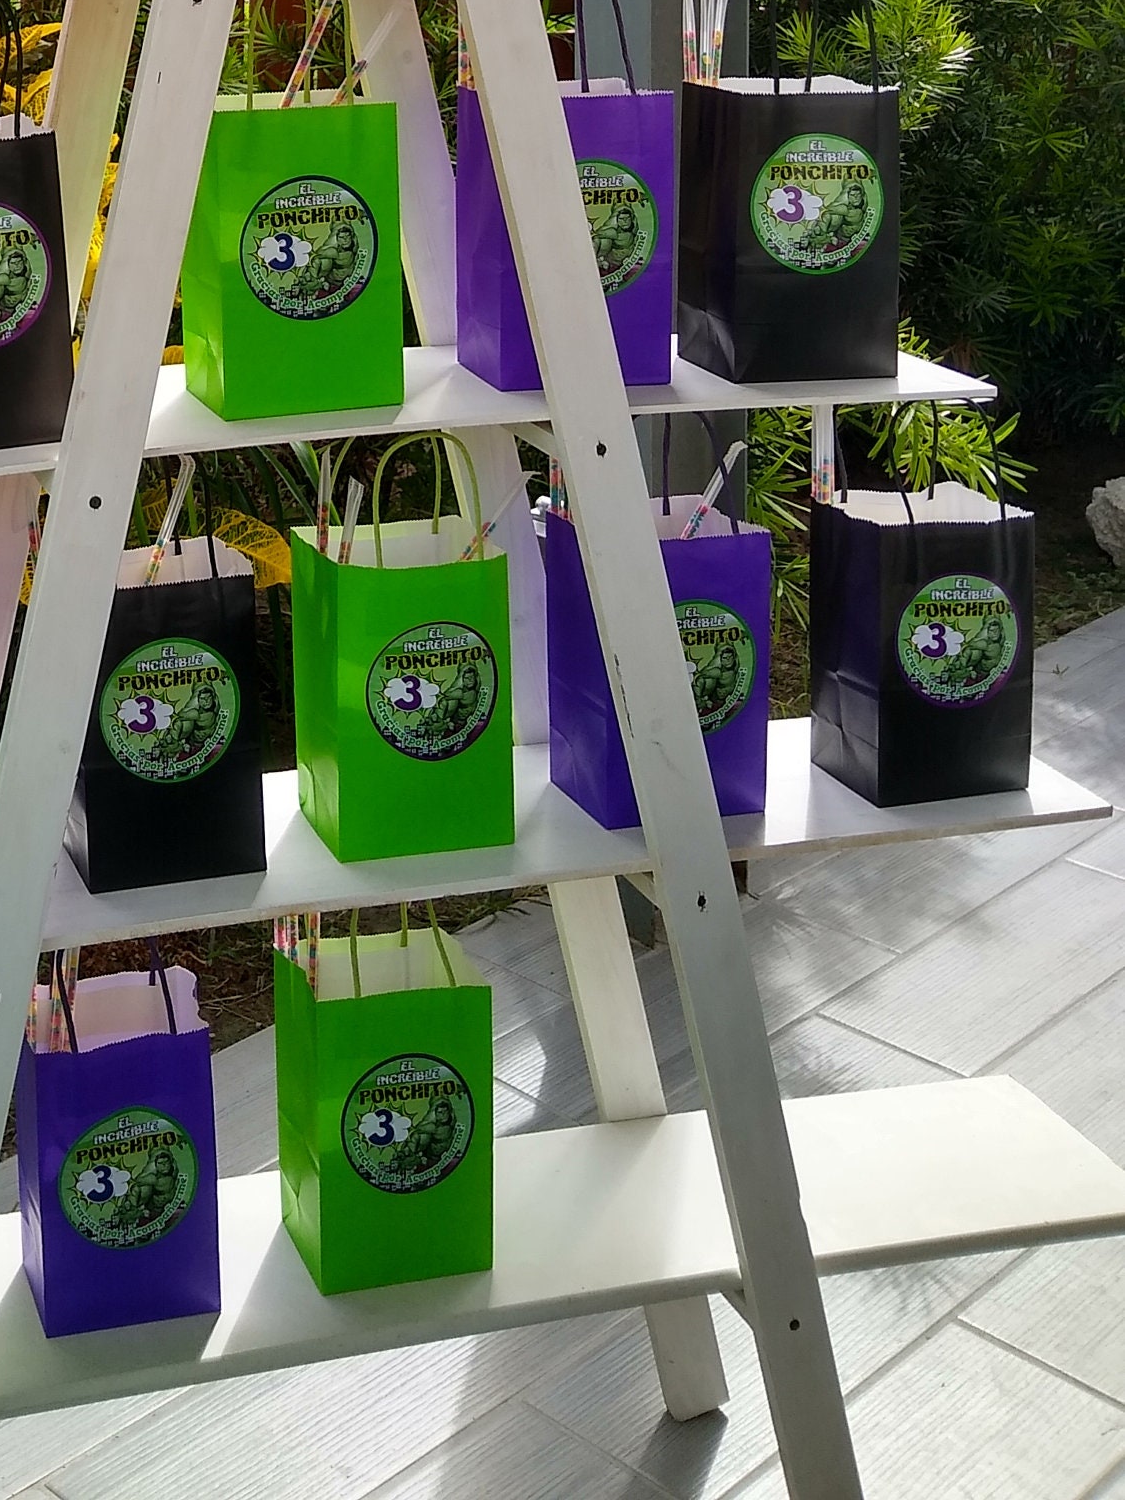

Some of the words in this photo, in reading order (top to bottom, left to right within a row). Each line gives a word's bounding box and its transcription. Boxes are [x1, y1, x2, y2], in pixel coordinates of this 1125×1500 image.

[809, 140, 826, 150] EL
[785, 152, 852, 162] INCREIBLE
[579, 176, 623, 188] REIBLE
[582, 167, 598, 177] EL
[770, 165, 869, 180] PONCHITO
[299, 184, 315, 194] EL
[581, 188, 638, 206] CHITO
[275, 192, 340, 209] INCREIBLE
[777, 186, 804, 222] 3
[258, 204, 357, 229] PONCHITO
[759, 212, 788, 252] Gracias
[790, 251, 811, 260] por
[817, 209, 875, 261] Acompañarme!
[268, 233, 295, 270] 3
[600, 231, 647, 286] ompañarme!
[251, 262, 280, 302] Gracias
[282, 300, 303, 308] por
[308, 249, 366, 308] Acompañarme!
[956, 579, 971, 588] EL
[933, 590, 992, 600] INCREIBLE
[685, 608, 701, 617] EL
[914, 601, 1005, 617] PONCHITO
[677, 616, 725, 628] CREIBLE
[404, 637, 468, 652] INCREIBLE
[428, 629, 444, 638] EL
[681, 627, 740, 645] CHITO
[921, 623, 946, 657] 3
[162, 647, 177, 657] EL
[385, 648, 482, 670] PONCHITO
[137, 655, 202, 672] INCREIBLE
[904, 648, 930, 687] Gracias
[931, 685, 951, 693] por
[118, 666, 219, 691] PONCHITO
[394, 675, 421, 710] 3
[699, 668, 748, 726] compañarme!
[128, 695, 155, 732] 3
[377, 702, 405, 740] Gracias
[406, 739, 427, 748] por
[433, 687, 489, 749] Acompañarme!
[111, 724, 140, 764] Gracias
[141, 762, 163, 770] por
[168, 710, 229, 770] Acompañarme!
[400, 1061, 415, 1071] EL
[377, 1069, 439, 1086] INCREIBLE
[360, 1080, 455, 1105] PONCHITO
[93, 1120, 159, 1144] INCREIBLE
[118, 1116, 133, 1126] EL
[368, 1109, 394, 1145] 3
[76, 1133, 177, 1164] PONCHITO
[352, 1138, 379, 1177] Gracias
[381, 1175, 401, 1183] por
[87, 1165, 114, 1202] 3
[70, 1196, 100, 1234] Gracias
